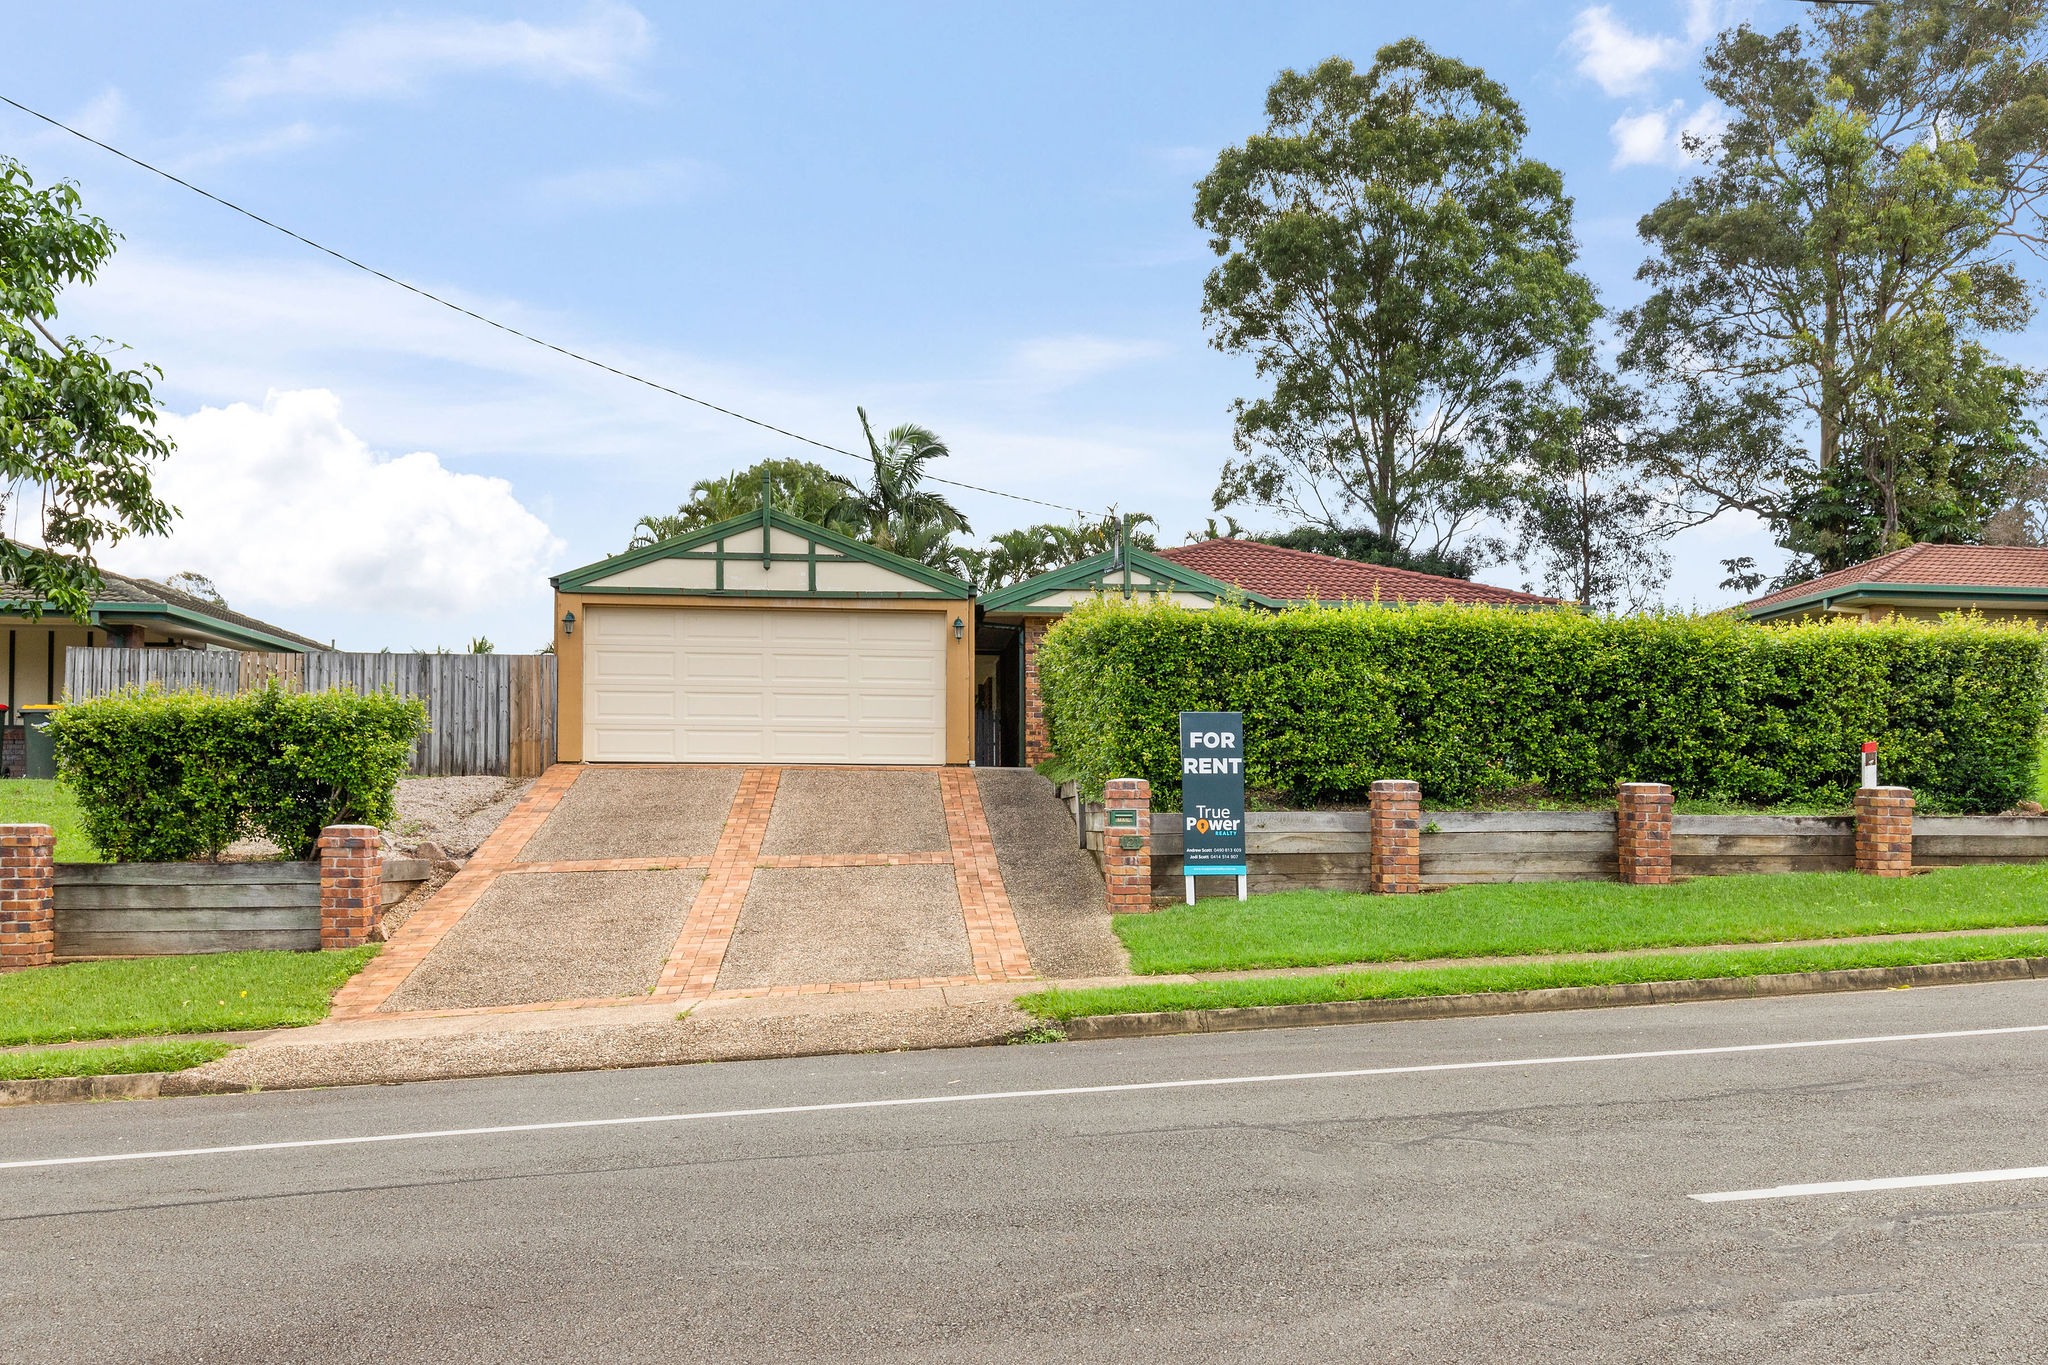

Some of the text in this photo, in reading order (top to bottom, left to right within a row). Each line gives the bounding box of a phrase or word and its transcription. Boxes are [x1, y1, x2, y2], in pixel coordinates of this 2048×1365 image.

[1190, 732, 1235, 748] FOR
[1184, 757, 1242, 774] RENT
[1196, 805, 1230, 819] True
[1186, 817, 1240, 832] Power
